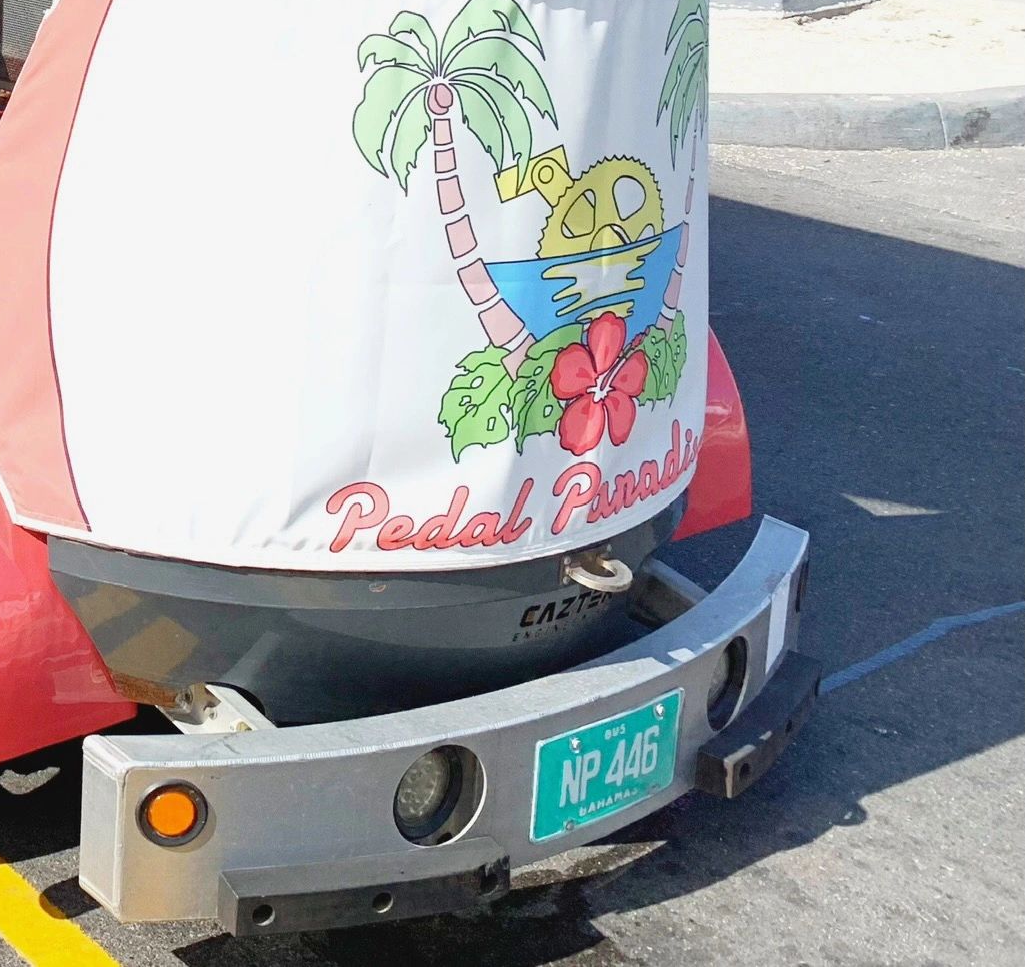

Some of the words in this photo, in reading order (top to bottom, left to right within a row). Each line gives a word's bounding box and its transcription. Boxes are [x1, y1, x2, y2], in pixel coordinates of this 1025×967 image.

[326, 478, 534, 553] Pedal
[559, 750, 602, 808] NP
[604, 725, 660, 786] 446
[604, 724, 626, 740] BUS
